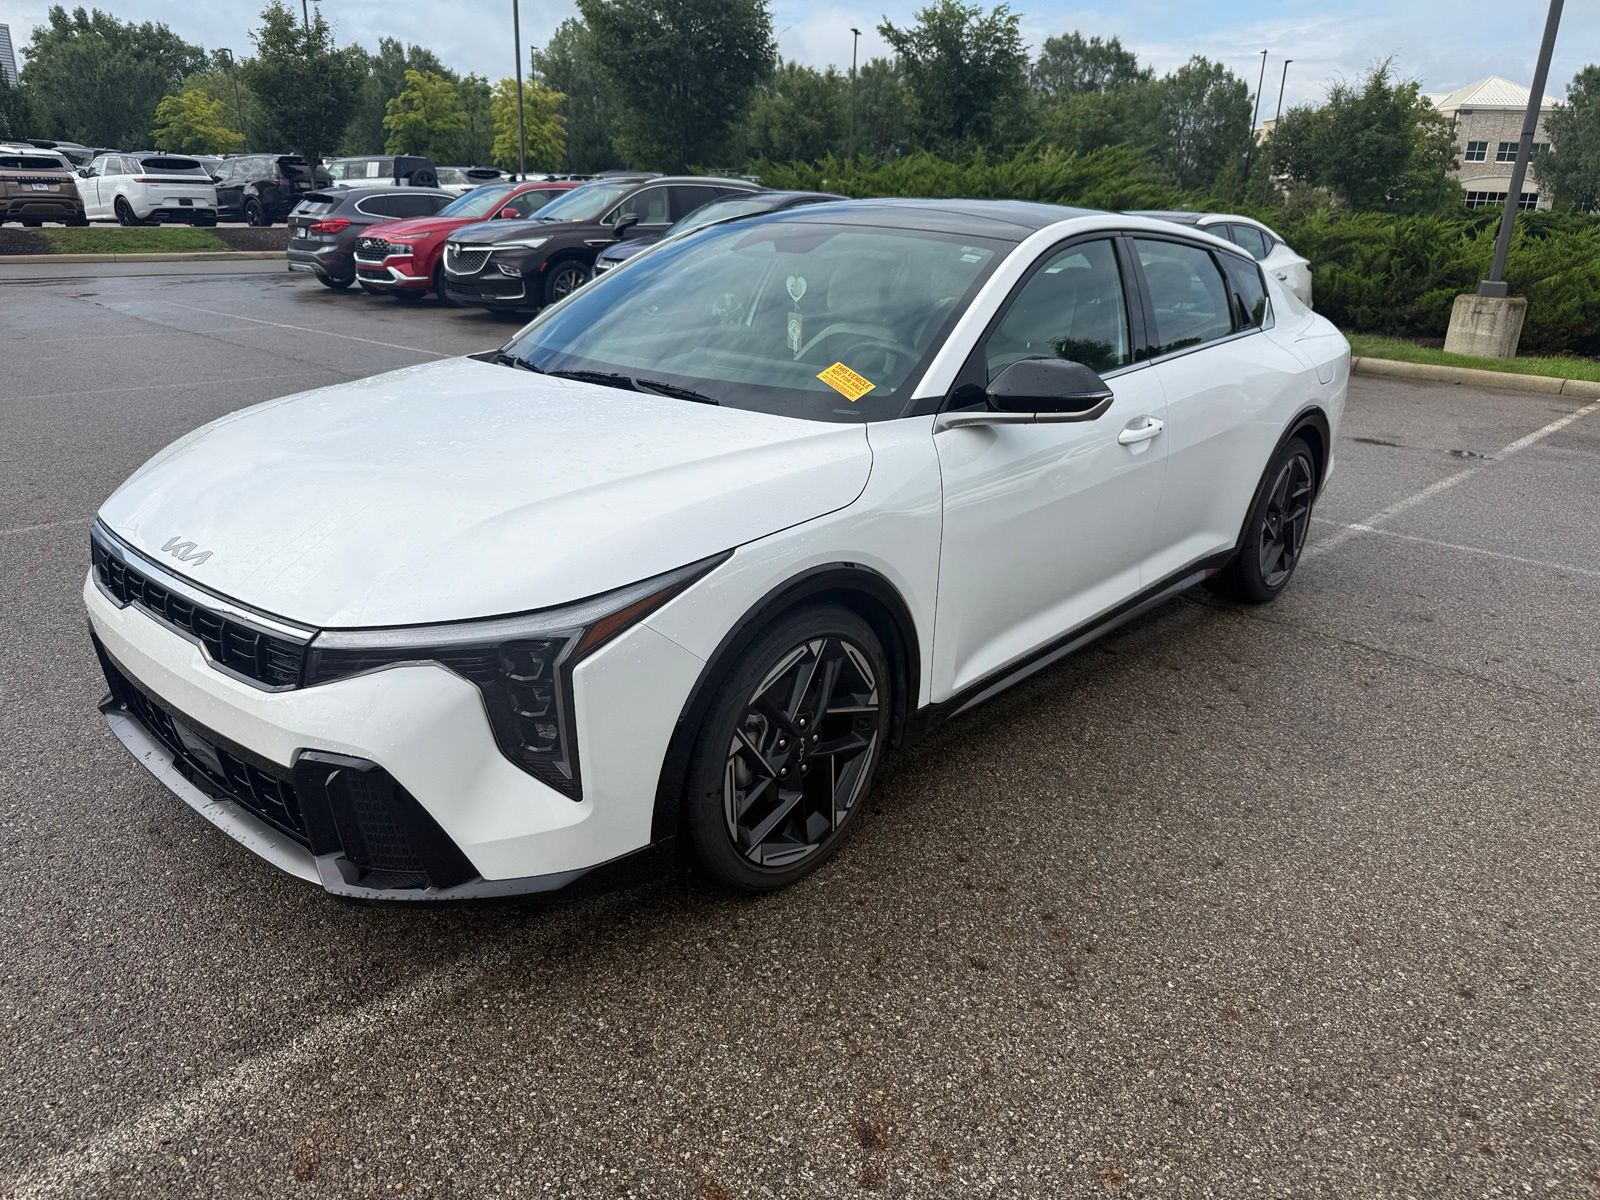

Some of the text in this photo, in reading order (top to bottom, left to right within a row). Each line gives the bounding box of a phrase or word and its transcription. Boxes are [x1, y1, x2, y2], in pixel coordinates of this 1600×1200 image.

[831, 368, 865, 392] NOT FOR SALE
[835, 364, 849, 374] THIS
[847, 371, 872, 390] VEHICLE
[161, 535, 214, 566] KIA
